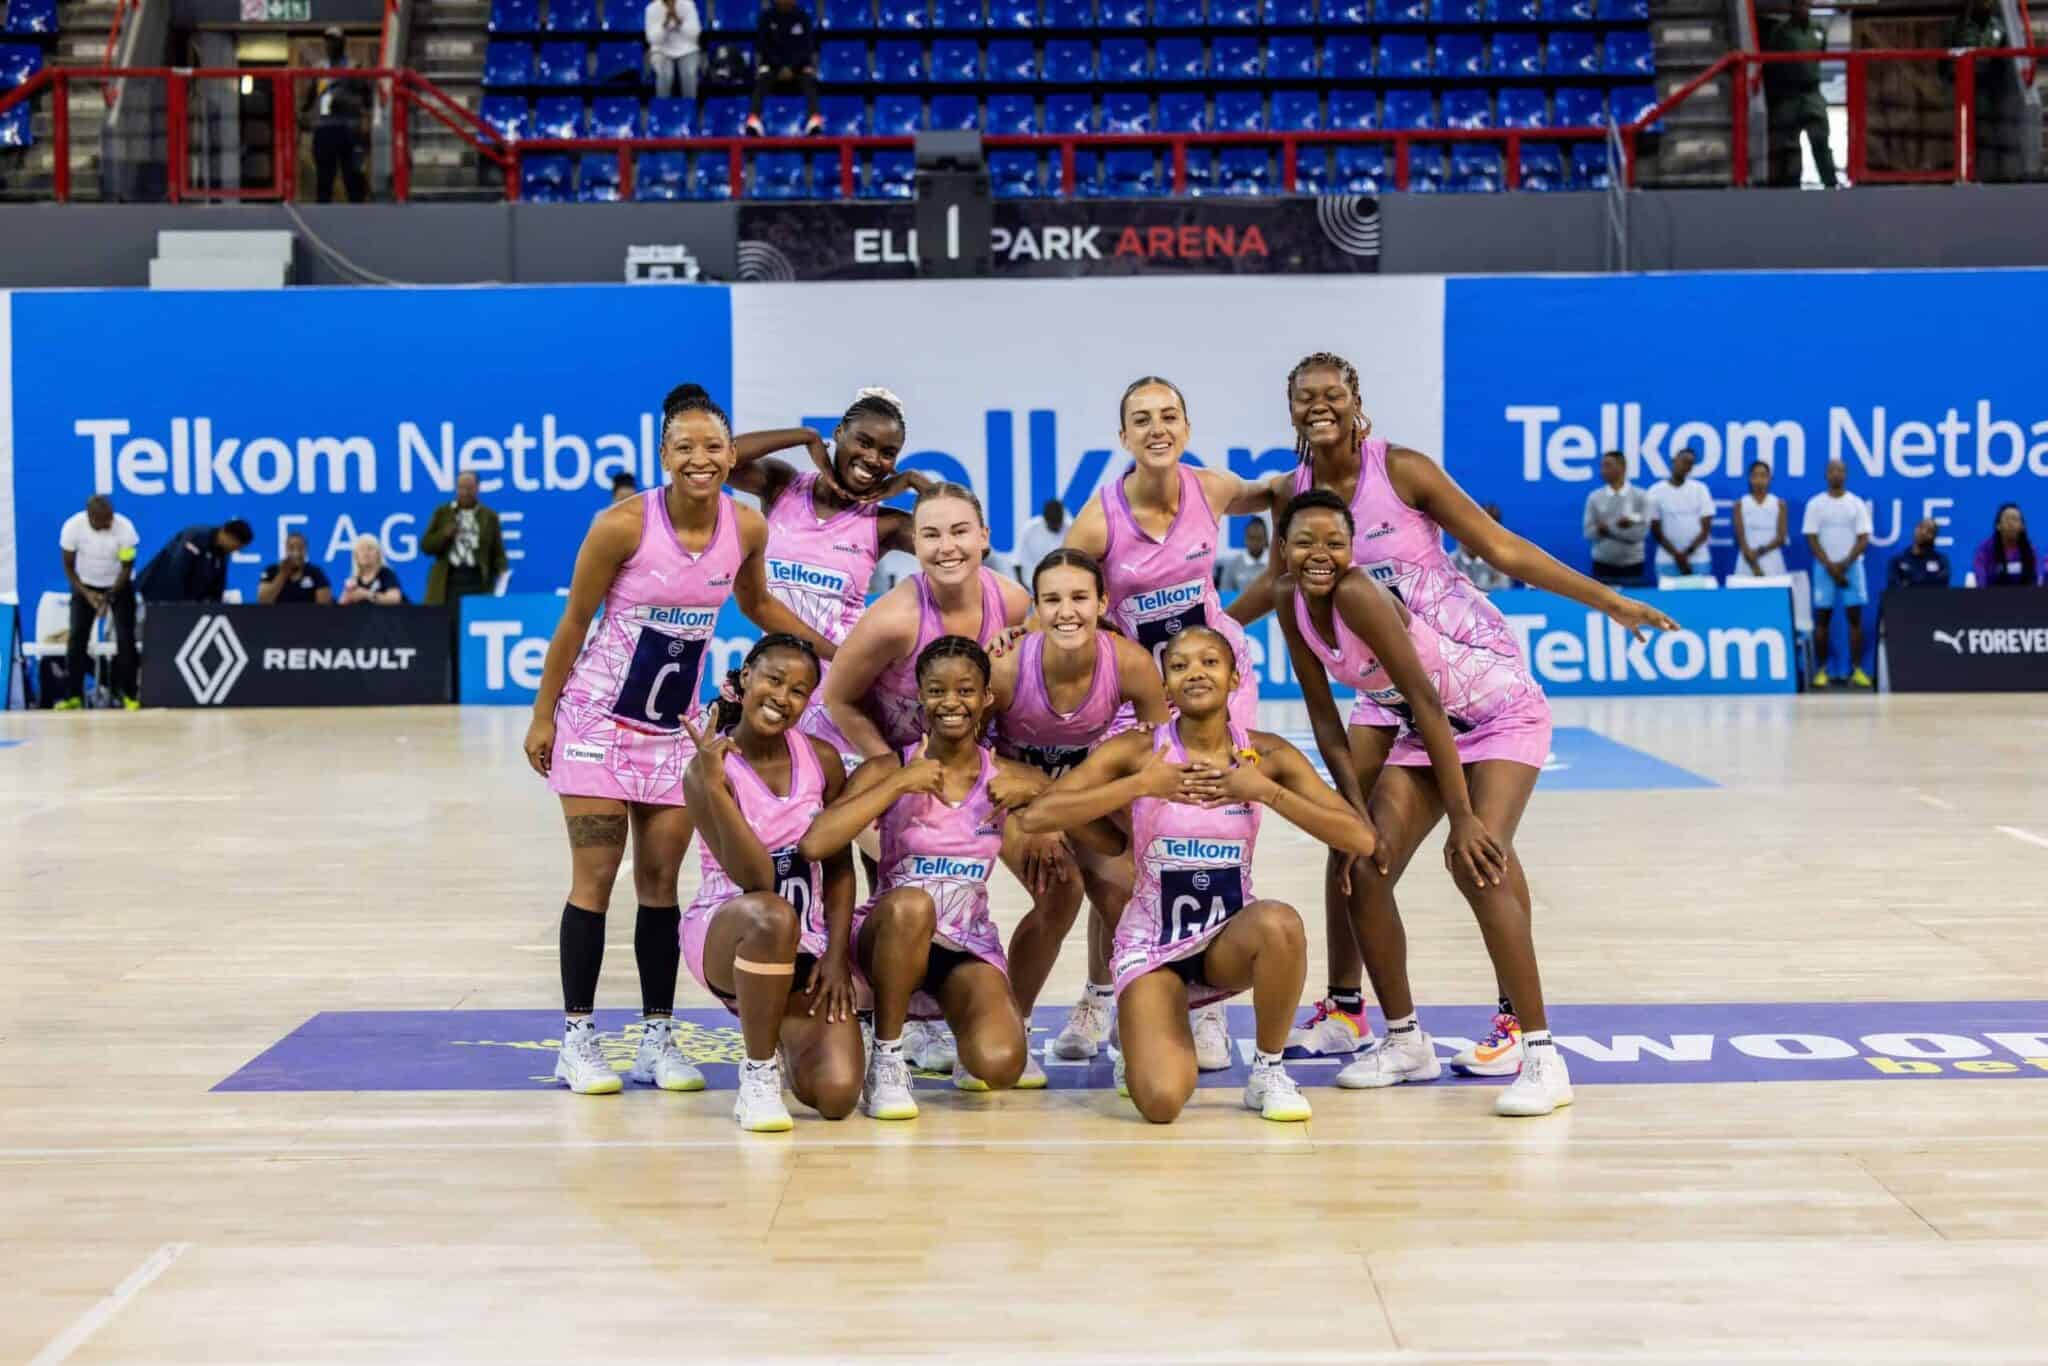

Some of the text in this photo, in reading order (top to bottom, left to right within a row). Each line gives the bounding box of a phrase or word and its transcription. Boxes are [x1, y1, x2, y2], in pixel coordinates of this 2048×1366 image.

[1115, 225, 1270, 257] ARENA
[75, 413, 673, 495] Telkom Netbal
[1506, 403, 1805, 481] Telkom
[231, 512, 526, 564] LEAGE
[769, 560, 844, 591] Telkom
[648, 607, 714, 626] Telkom
[1968, 628, 2048, 654] FOREVE
[263, 648, 417, 670] RENAULT
[645, 662, 680, 721] C
[1162, 839, 1241, 859] Telkom
[912, 856, 985, 879] Telkom
[779, 877, 811, 933] D
[1170, 894, 1227, 944] GA
